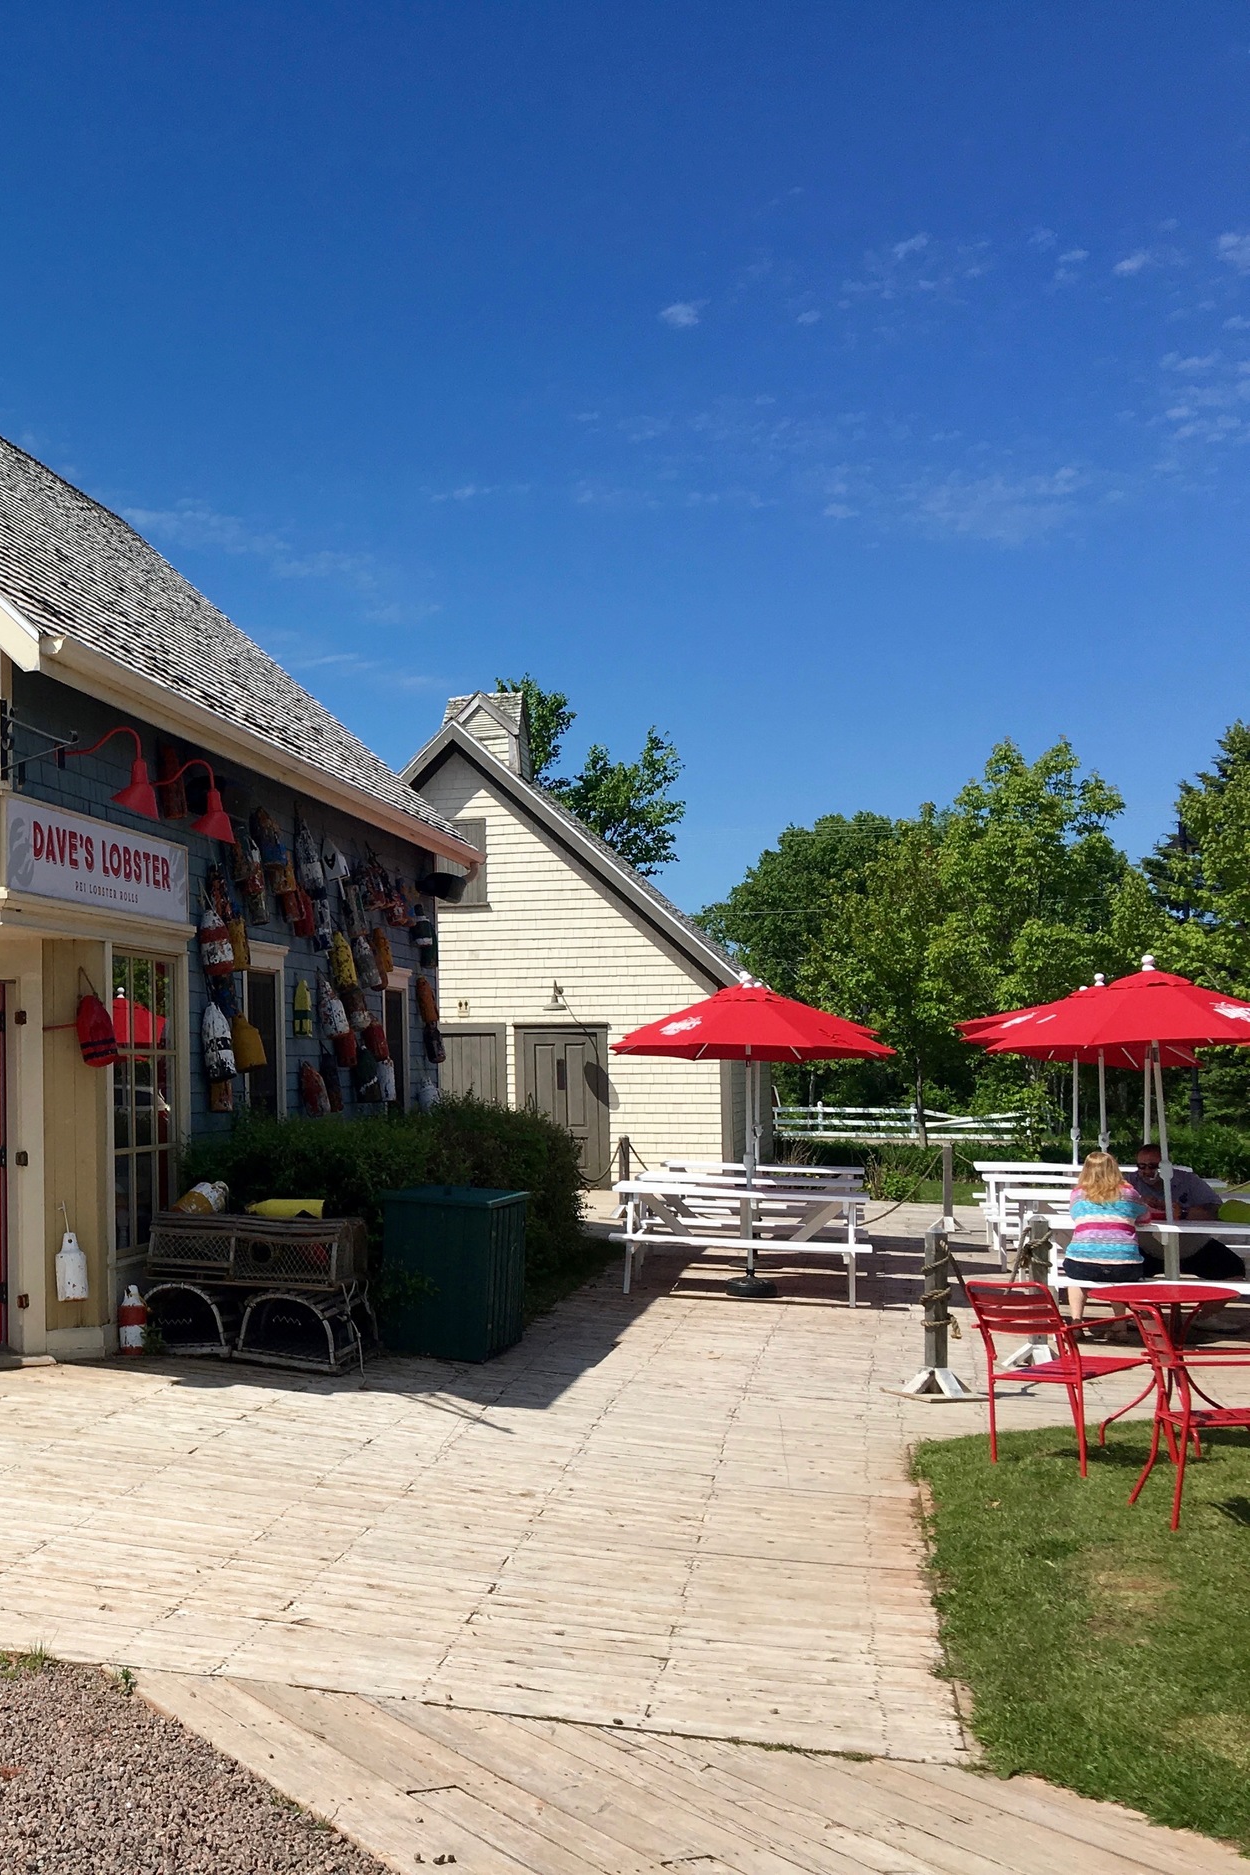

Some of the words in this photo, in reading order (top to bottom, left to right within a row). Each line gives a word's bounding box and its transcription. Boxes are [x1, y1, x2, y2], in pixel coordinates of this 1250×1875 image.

[32, 820, 95, 873] DAVE'S
[101, 840, 172, 892] LOBSTER
[75, 881, 87, 892] PEI
[89, 884, 117, 899] LOBSTER
